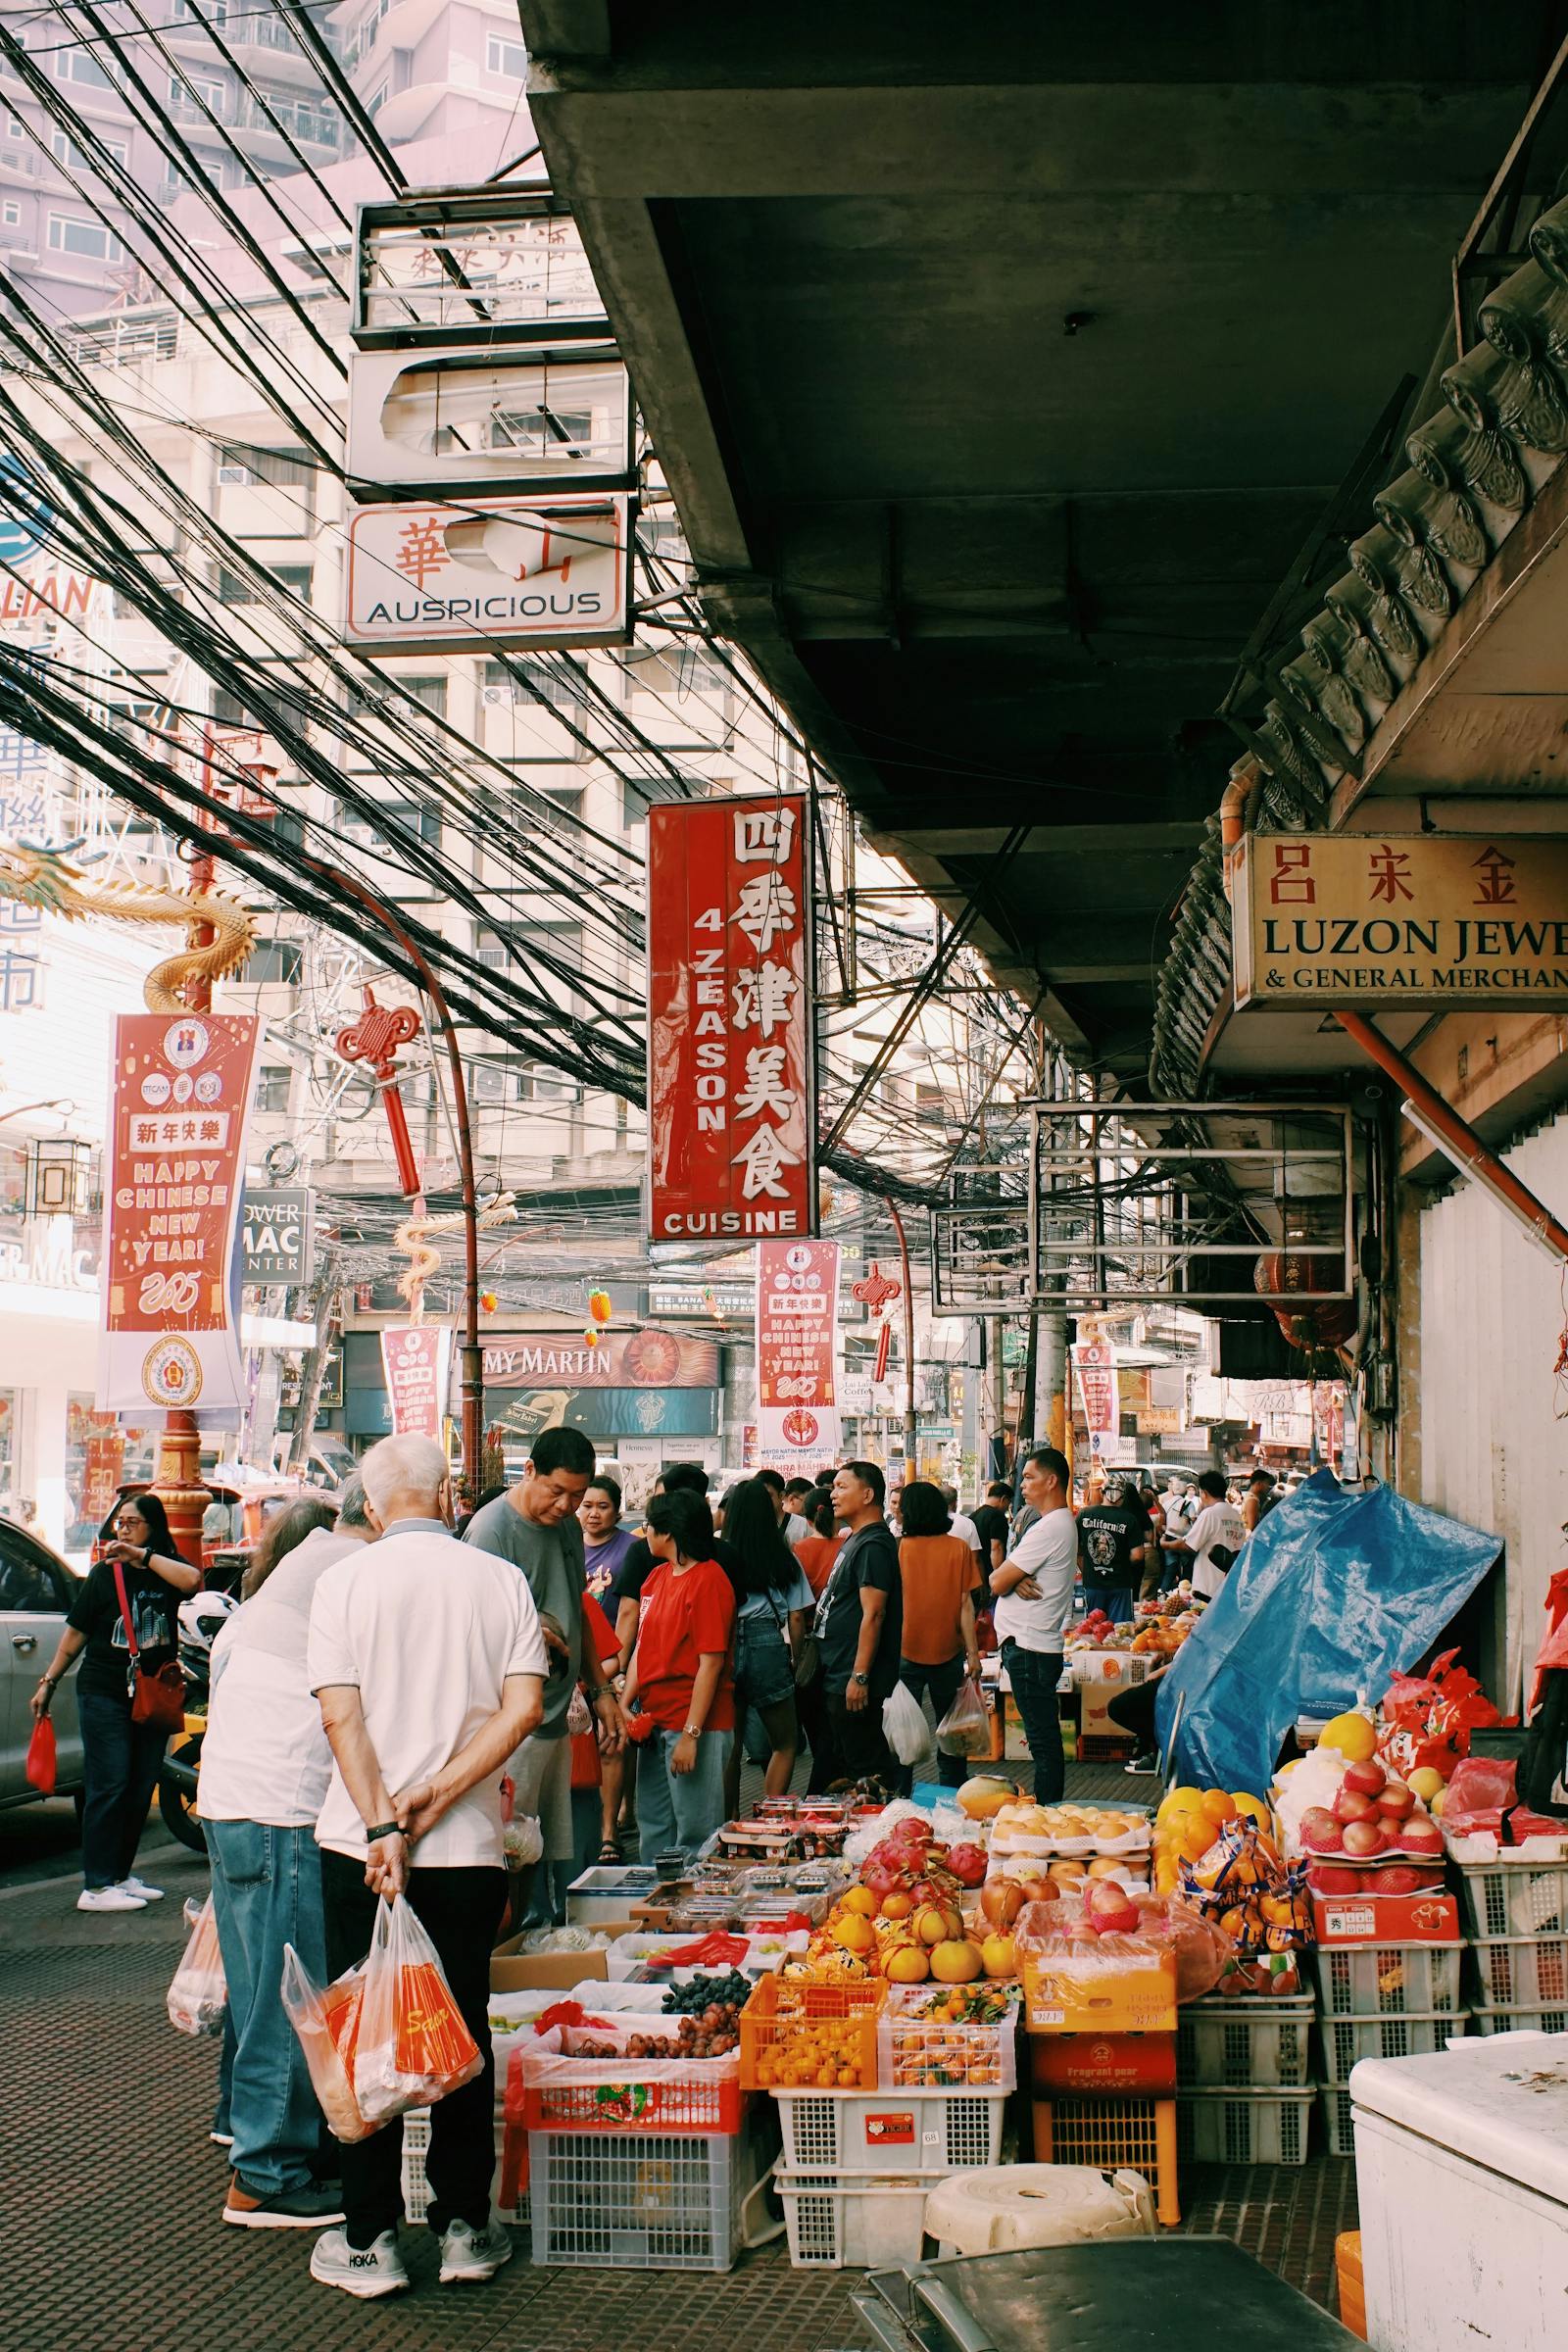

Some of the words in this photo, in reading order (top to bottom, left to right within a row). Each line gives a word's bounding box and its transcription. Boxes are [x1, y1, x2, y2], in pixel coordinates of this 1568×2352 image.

[367, 592, 602, 624] AUSPICIOUS
[694, 907, 725, 932] 4
[1262, 918, 1441, 956] LUZON
[1265, 968, 1287, 989] &
[1293, 968, 1424, 989] GENERAL
[1431, 967, 1568, 989] MERCHAN
[727, 807, 801, 1200] 四季津美食
[137, 1120, 220, 1144] 新年快樂
[133, 1159, 220, 1184] HAPPY
[116, 1185, 228, 1209] CHINESE
[149, 1212, 201, 1236] NEW
[244, 1203, 299, 1223] OWER
[663, 1209, 798, 1234] CUISINE
[132, 1239, 205, 1264] YEAR!
[770, 1318, 824, 1331] HAPPY
[760, 1331, 830, 1344] CHINESE
[484, 1350, 515, 1374] MY
[521, 1347, 612, 1374] MARTIN
[779, 1346, 815, 1358] NEW
[1066, 2067, 1112, 2078] Fragrant
[924, 2133, 937, 2142] 68
[349, 2252, 378, 2269] HOKA
[470, 2238, 489, 2251] HO
